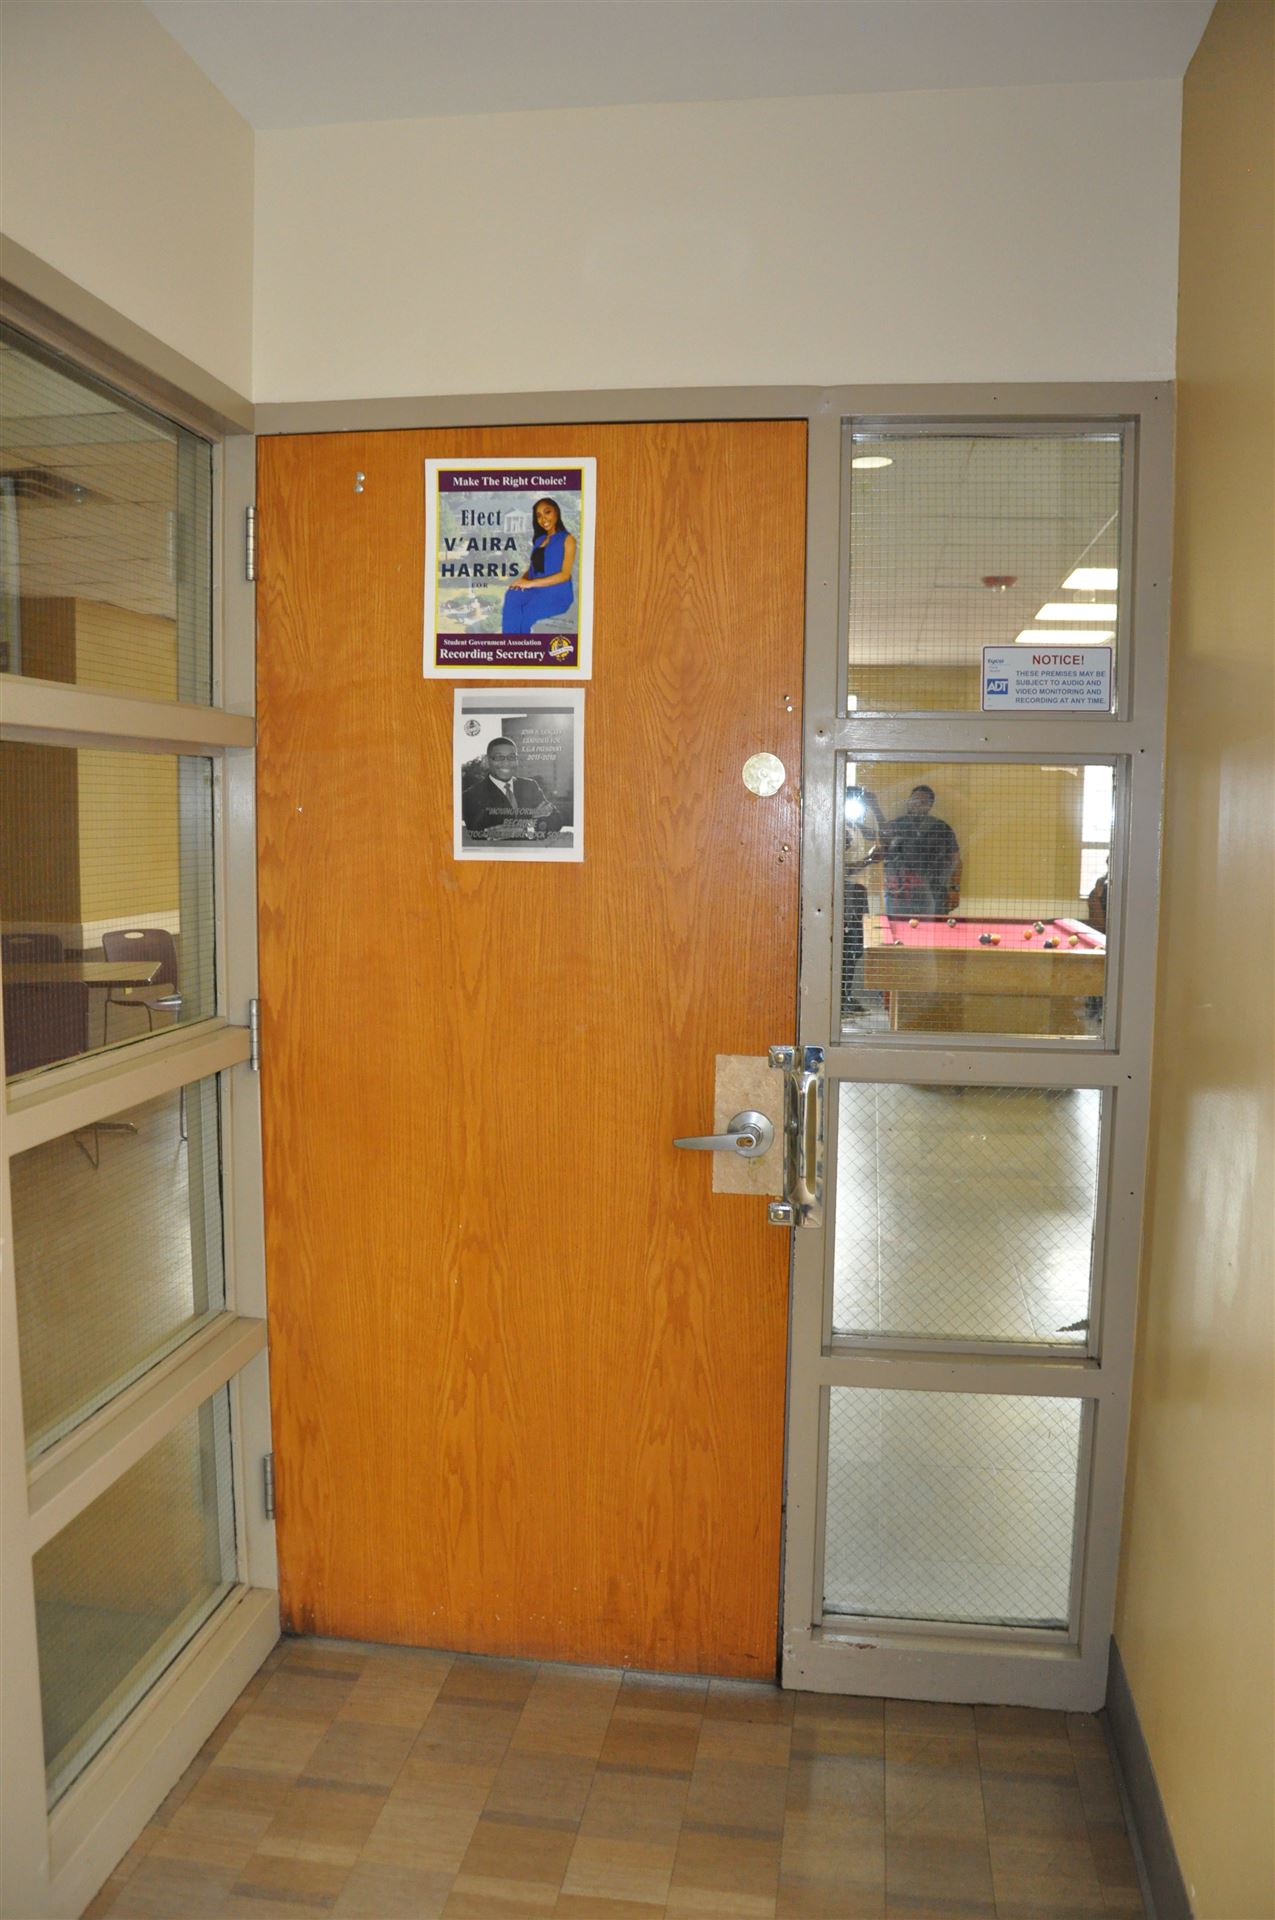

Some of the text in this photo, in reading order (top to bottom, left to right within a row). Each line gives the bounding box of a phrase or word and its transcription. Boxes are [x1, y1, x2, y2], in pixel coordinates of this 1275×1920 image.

[453, 476, 567, 488] Make The Right Choice!
[461, 509, 501, 526] Elect
[441, 563, 519, 577] HARRIS
[440, 649, 545, 661] Recording Secretary
[1032, 655, 1084, 665] NOTICE!
[988, 680, 1008, 691] ADT
